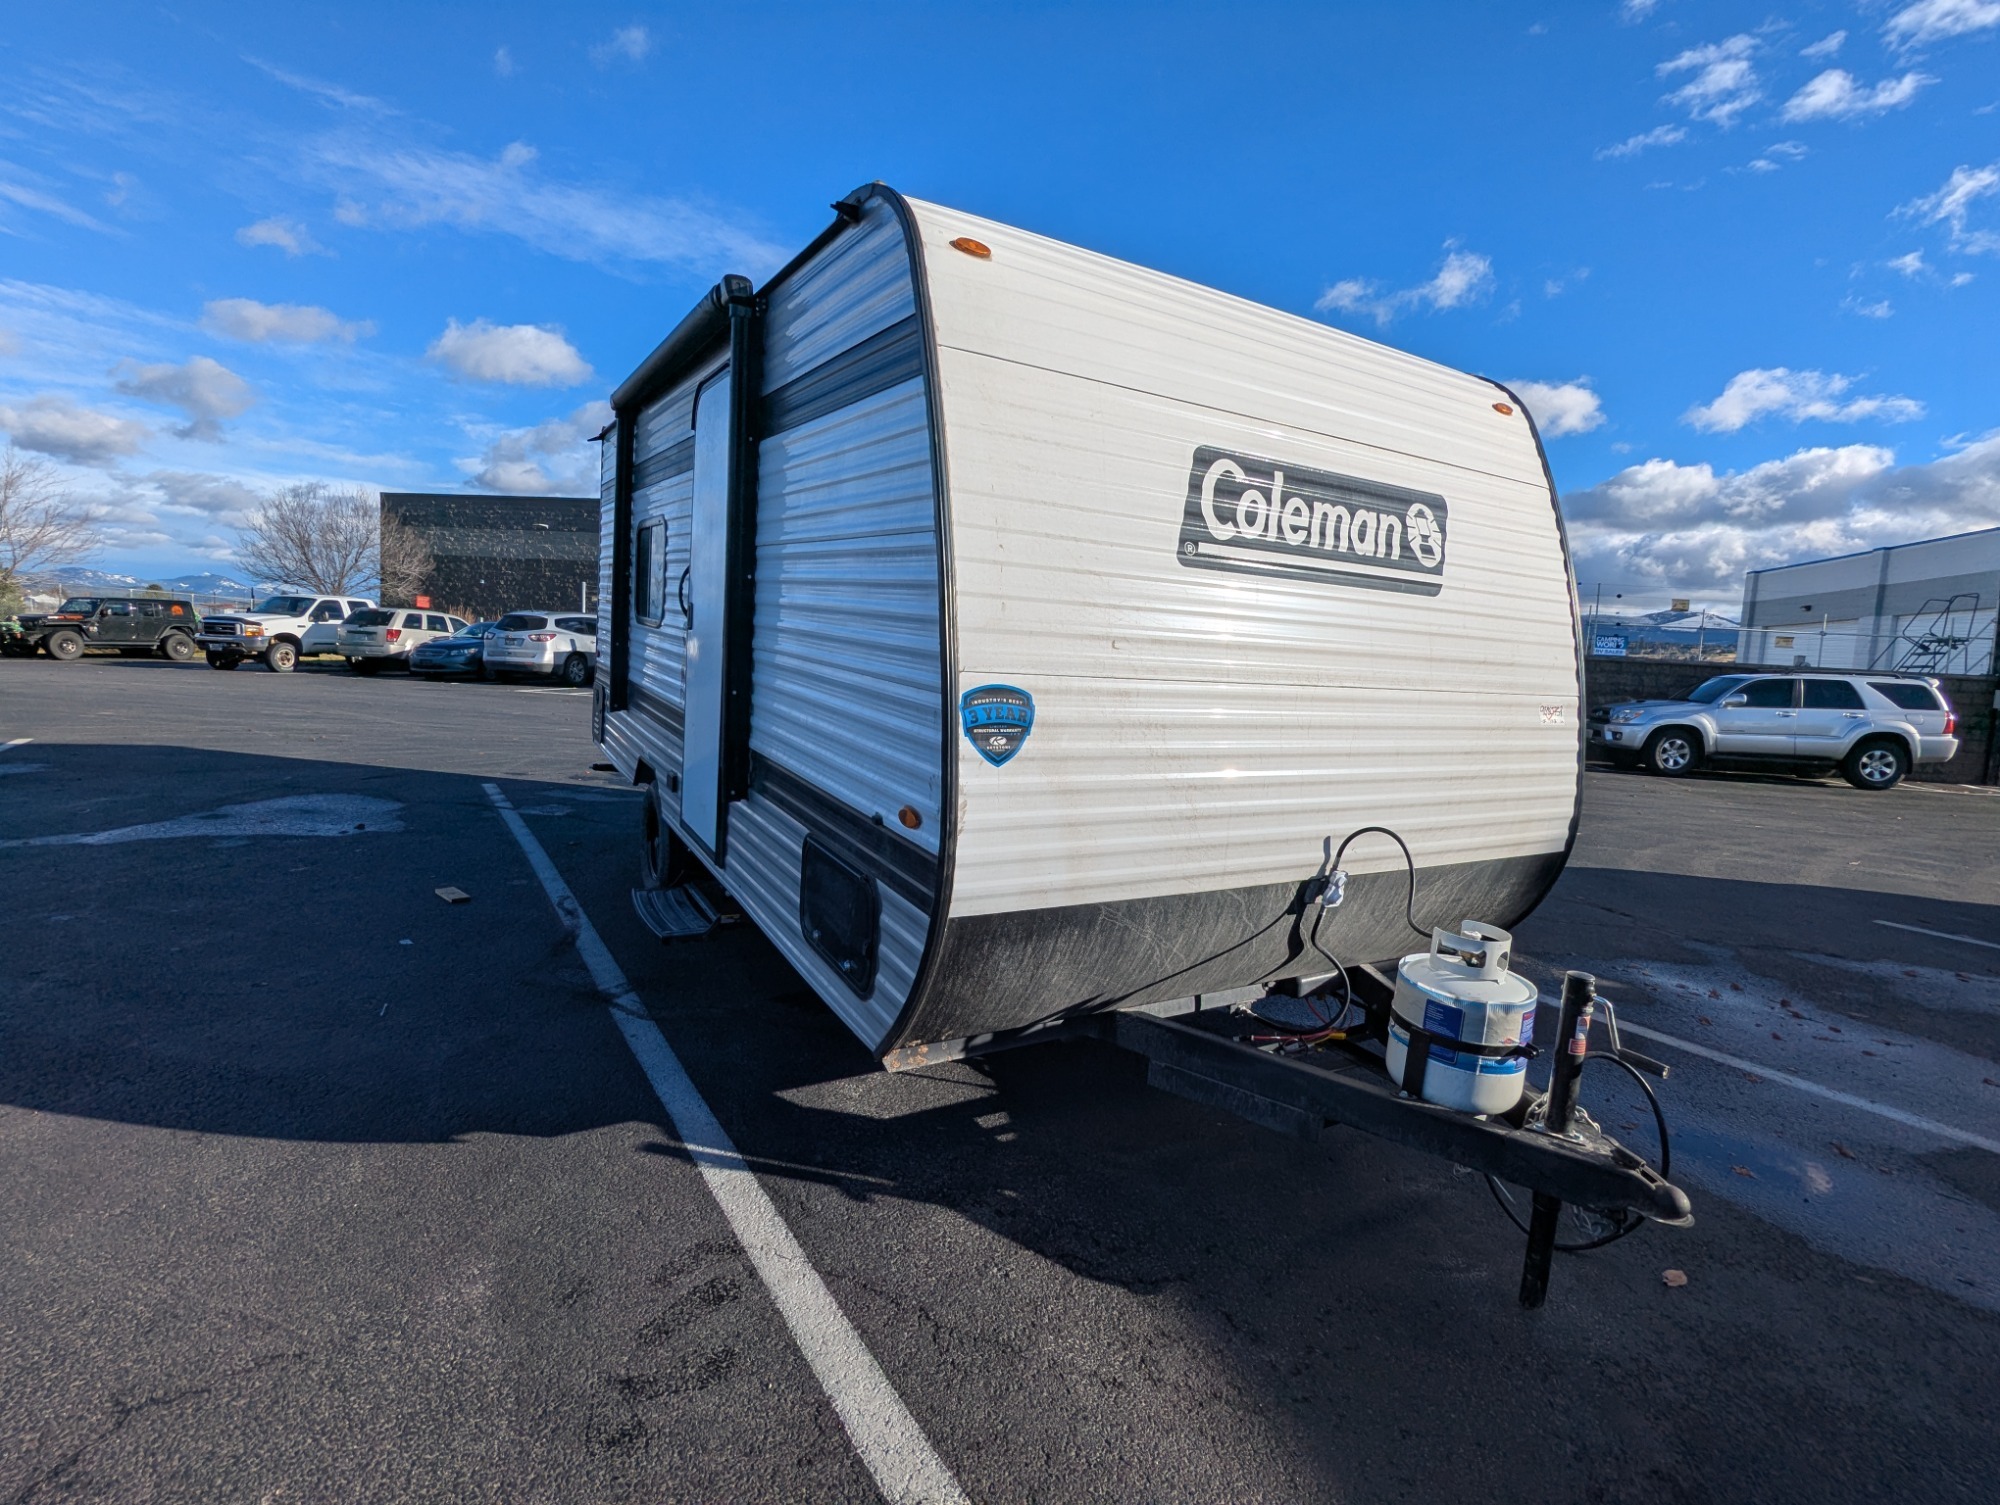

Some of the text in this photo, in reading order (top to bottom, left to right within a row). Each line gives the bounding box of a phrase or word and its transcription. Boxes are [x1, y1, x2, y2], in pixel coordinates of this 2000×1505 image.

[1200, 458, 1402, 560] Coleman
[971, 697, 1007, 705] INDUSTRY'S
[968, 705, 1027, 724] 3 YEAR
